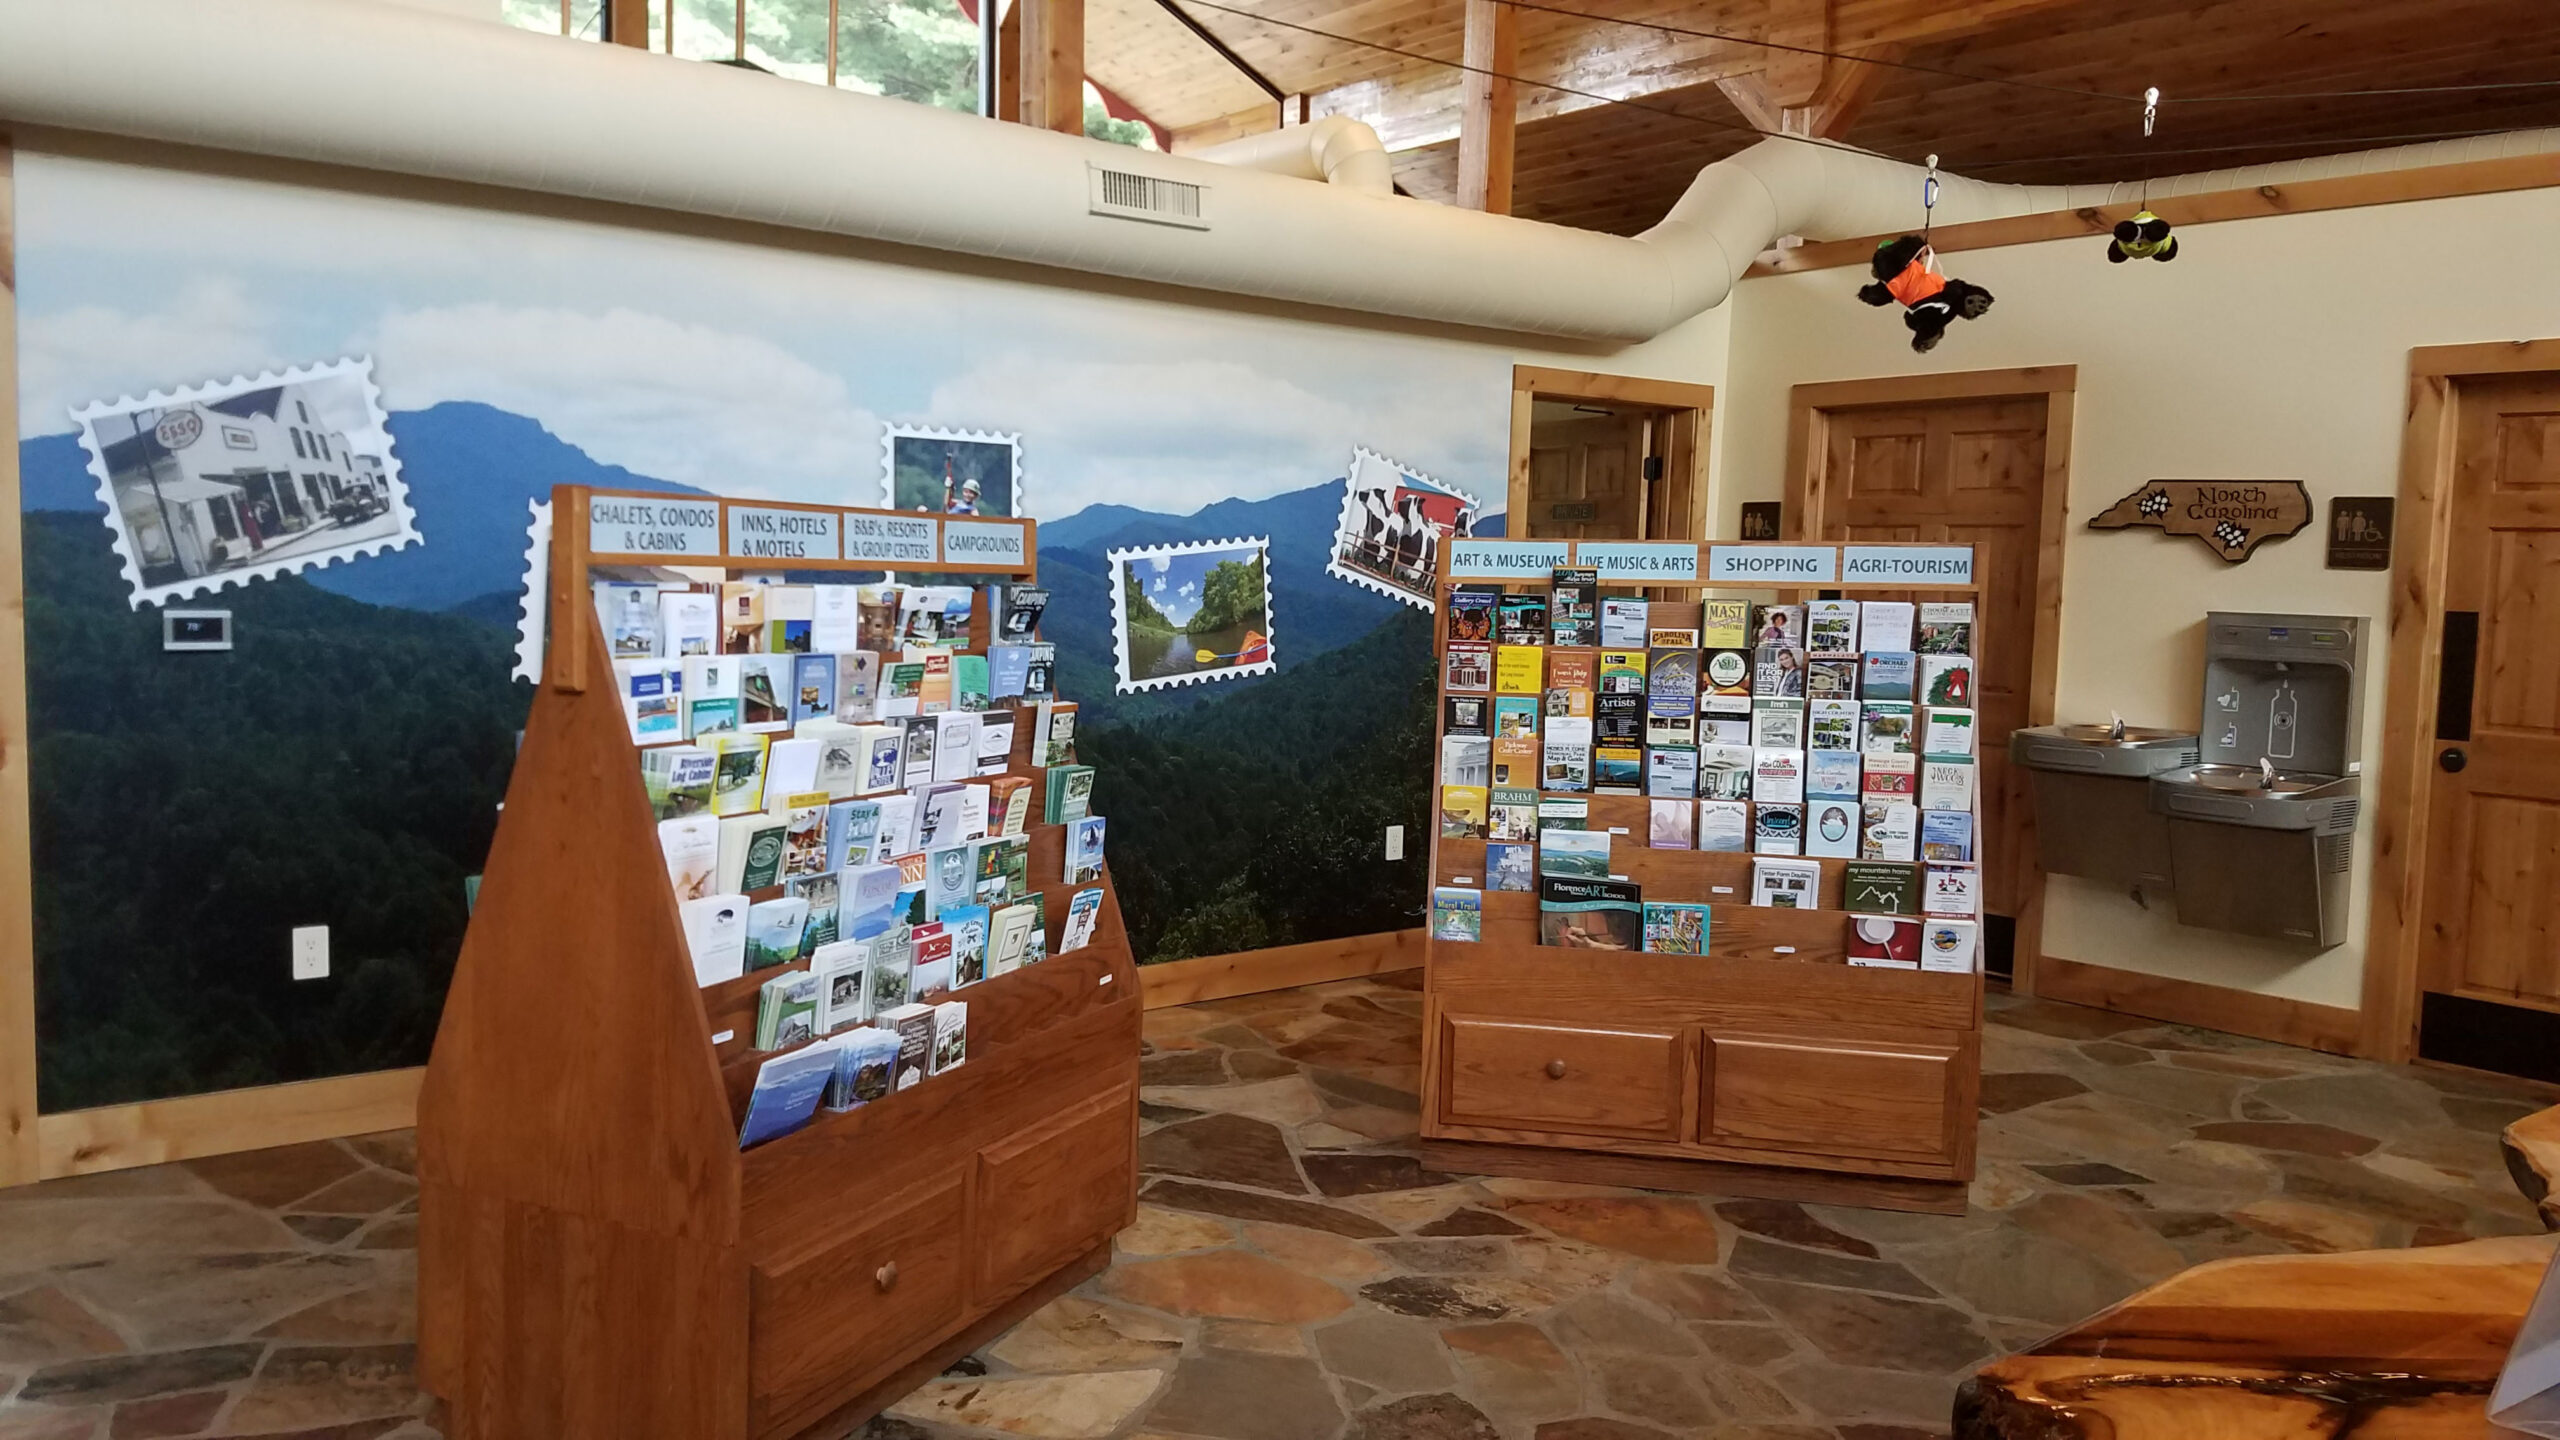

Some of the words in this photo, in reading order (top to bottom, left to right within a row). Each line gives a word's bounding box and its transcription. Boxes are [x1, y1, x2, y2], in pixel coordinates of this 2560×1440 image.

[2196, 487, 2267, 505] North
[591, 504, 657, 526] CHALETS,
[660, 507, 716, 529] CONDOS
[2186, 503, 2280, 521] Carolina
[741, 514, 777, 535] INNS,
[780, 516, 827, 536] HOTELS
[887, 520, 928, 540] RESORTS
[624, 532, 636, 550] &
[637, 532, 687, 551] CABINS
[742, 540, 753, 556] &
[754, 540, 805, 558] MOTELS
[948, 534, 1020, 554] CAMPGROUNDS
[853, 541, 861, 556] &
[862, 542, 892, 558] GROUP
[894, 543, 930, 560] CENTERS
[1454, 552, 1481, 567] ART
[1483, 553, 1494, 568] &
[1496, 552, 1567, 569] MUSEUMS
[1607, 556, 1647, 570] MUSIC
[1649, 556, 1660, 571] &
[1662, 556, 1695, 571] ARTS
[1725, 557, 1818, 572] SHOPPING
[1848, 558, 1969, 575] AGRI-TOURISM
[1709, 604, 1744, 619] MAST
[1652, 631, 1693, 643] CAROLINA
[1599, 696, 1636, 707] Artists
[672, 771, 687, 783] Log
[1493, 791, 1532, 802] BRAHM
[850, 808, 872, 821] Stay
[872, 806, 879, 817] &
[1848, 867, 1858, 875] my
[1860, 866, 1891, 874] mountain
[1553, 882, 1585, 893] Florence
[1584, 885, 1608, 898] ART
[1437, 901, 1458, 909] Mural
[1460, 901, 1476, 909] Trail
